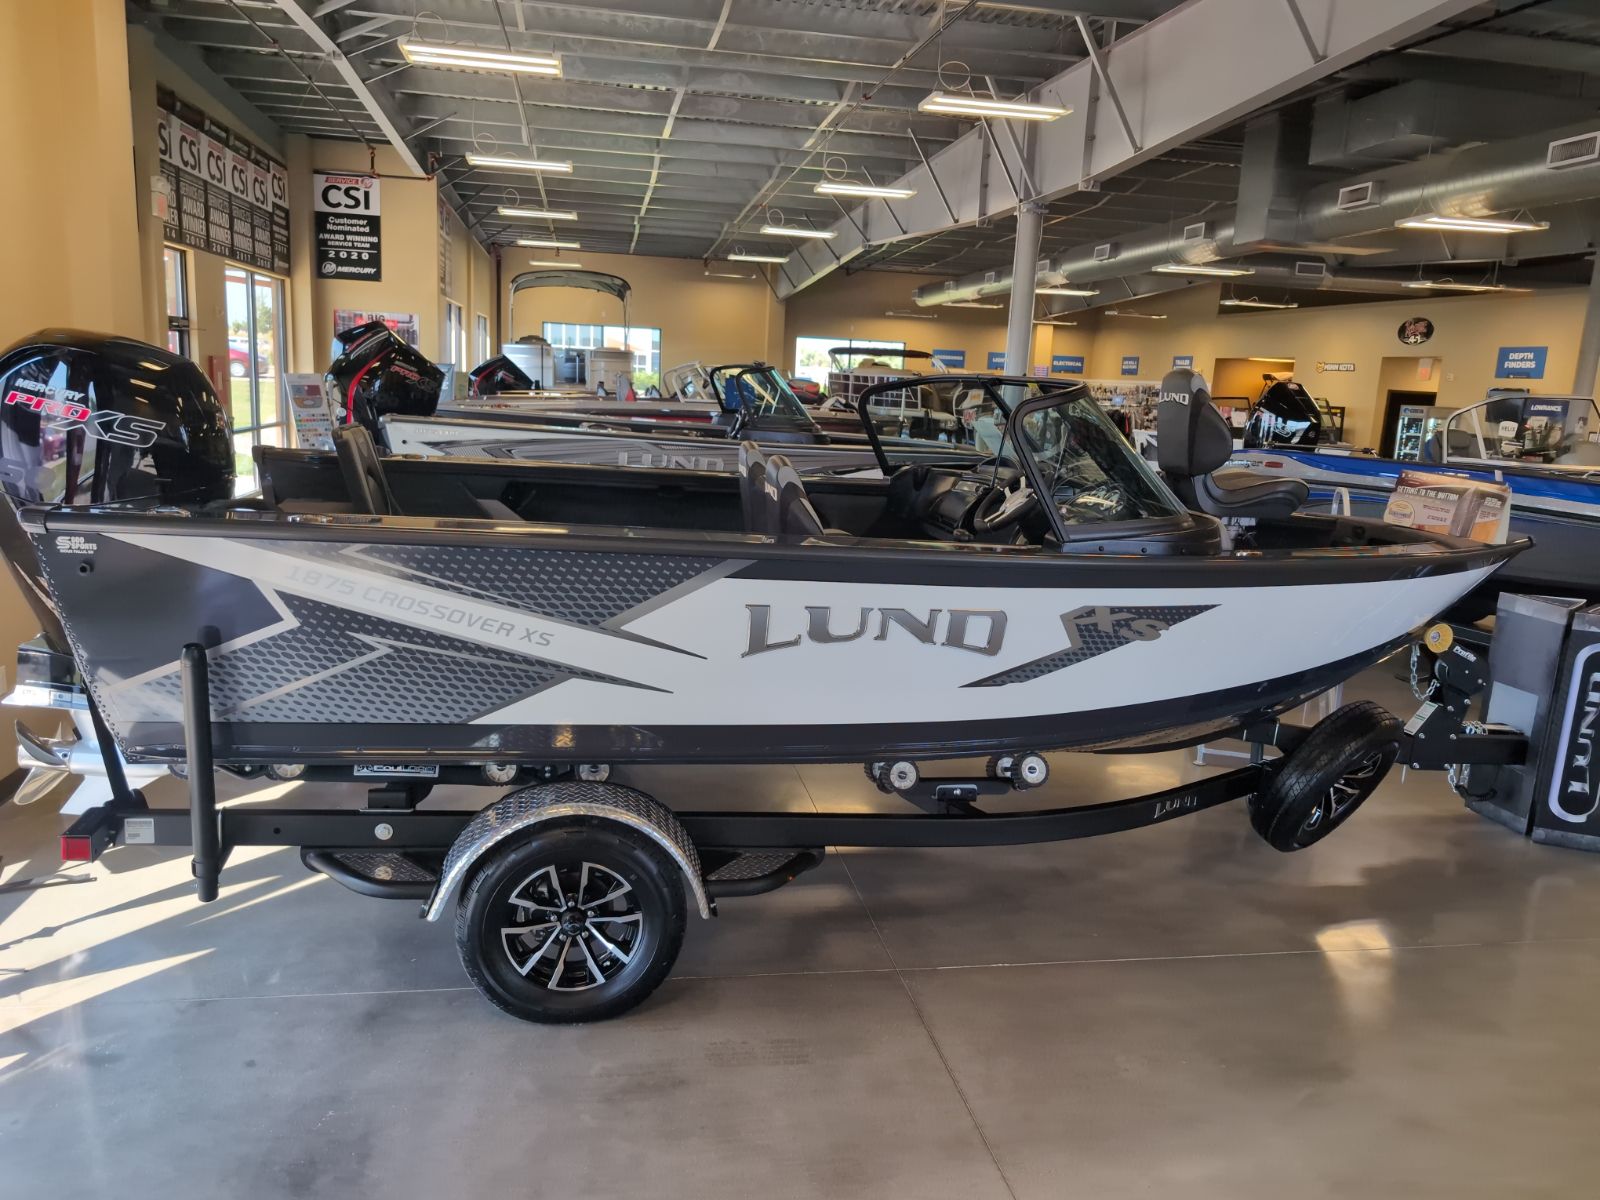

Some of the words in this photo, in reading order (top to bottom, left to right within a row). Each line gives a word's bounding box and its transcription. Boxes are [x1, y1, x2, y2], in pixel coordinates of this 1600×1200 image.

[327, 177, 358, 185] SERVICE
[183, 196, 205, 219] AWARD
[210, 207, 230, 229] AWARD
[328, 216, 368, 226] Customer
[182, 212, 207, 236] WINNER
[326, 224, 370, 233] Nominated
[209, 222, 231, 245] WINNER
[319, 233, 345, 241] AWARD
[346, 234, 378, 243] WINNING
[327, 240, 352, 248] SERVICE
[328, 251, 369, 260] 2020
[337, 266, 377, 275] MERCURY
[1508, 352, 1534, 360] DEPTH
[1324, 363, 1339, 371] MINN
[1339, 363, 1354, 371] KOTA
[1504, 361, 1536, 369] FINDERS
[15, 378, 85, 401] MERCURY
[1159, 392, 1189, 405] LUND
[1530, 404, 1563, 412] LOWRANCE
[5, 391, 91, 421] PRO
[48, 410, 167, 447] XS
[618, 451, 724, 471] LUND
[1397, 486, 1419, 495] GETTING
[1426, 489, 1438, 497] THE
[1437, 491, 1459, 500] BOTTOM
[71, 543, 97, 551] SPORTS
[287, 565, 355, 597] 1875
[362, 586, 515, 637] CROSSOVER
[519, 627, 555, 648] XS
[740, 603, 1009, 659] LUND
